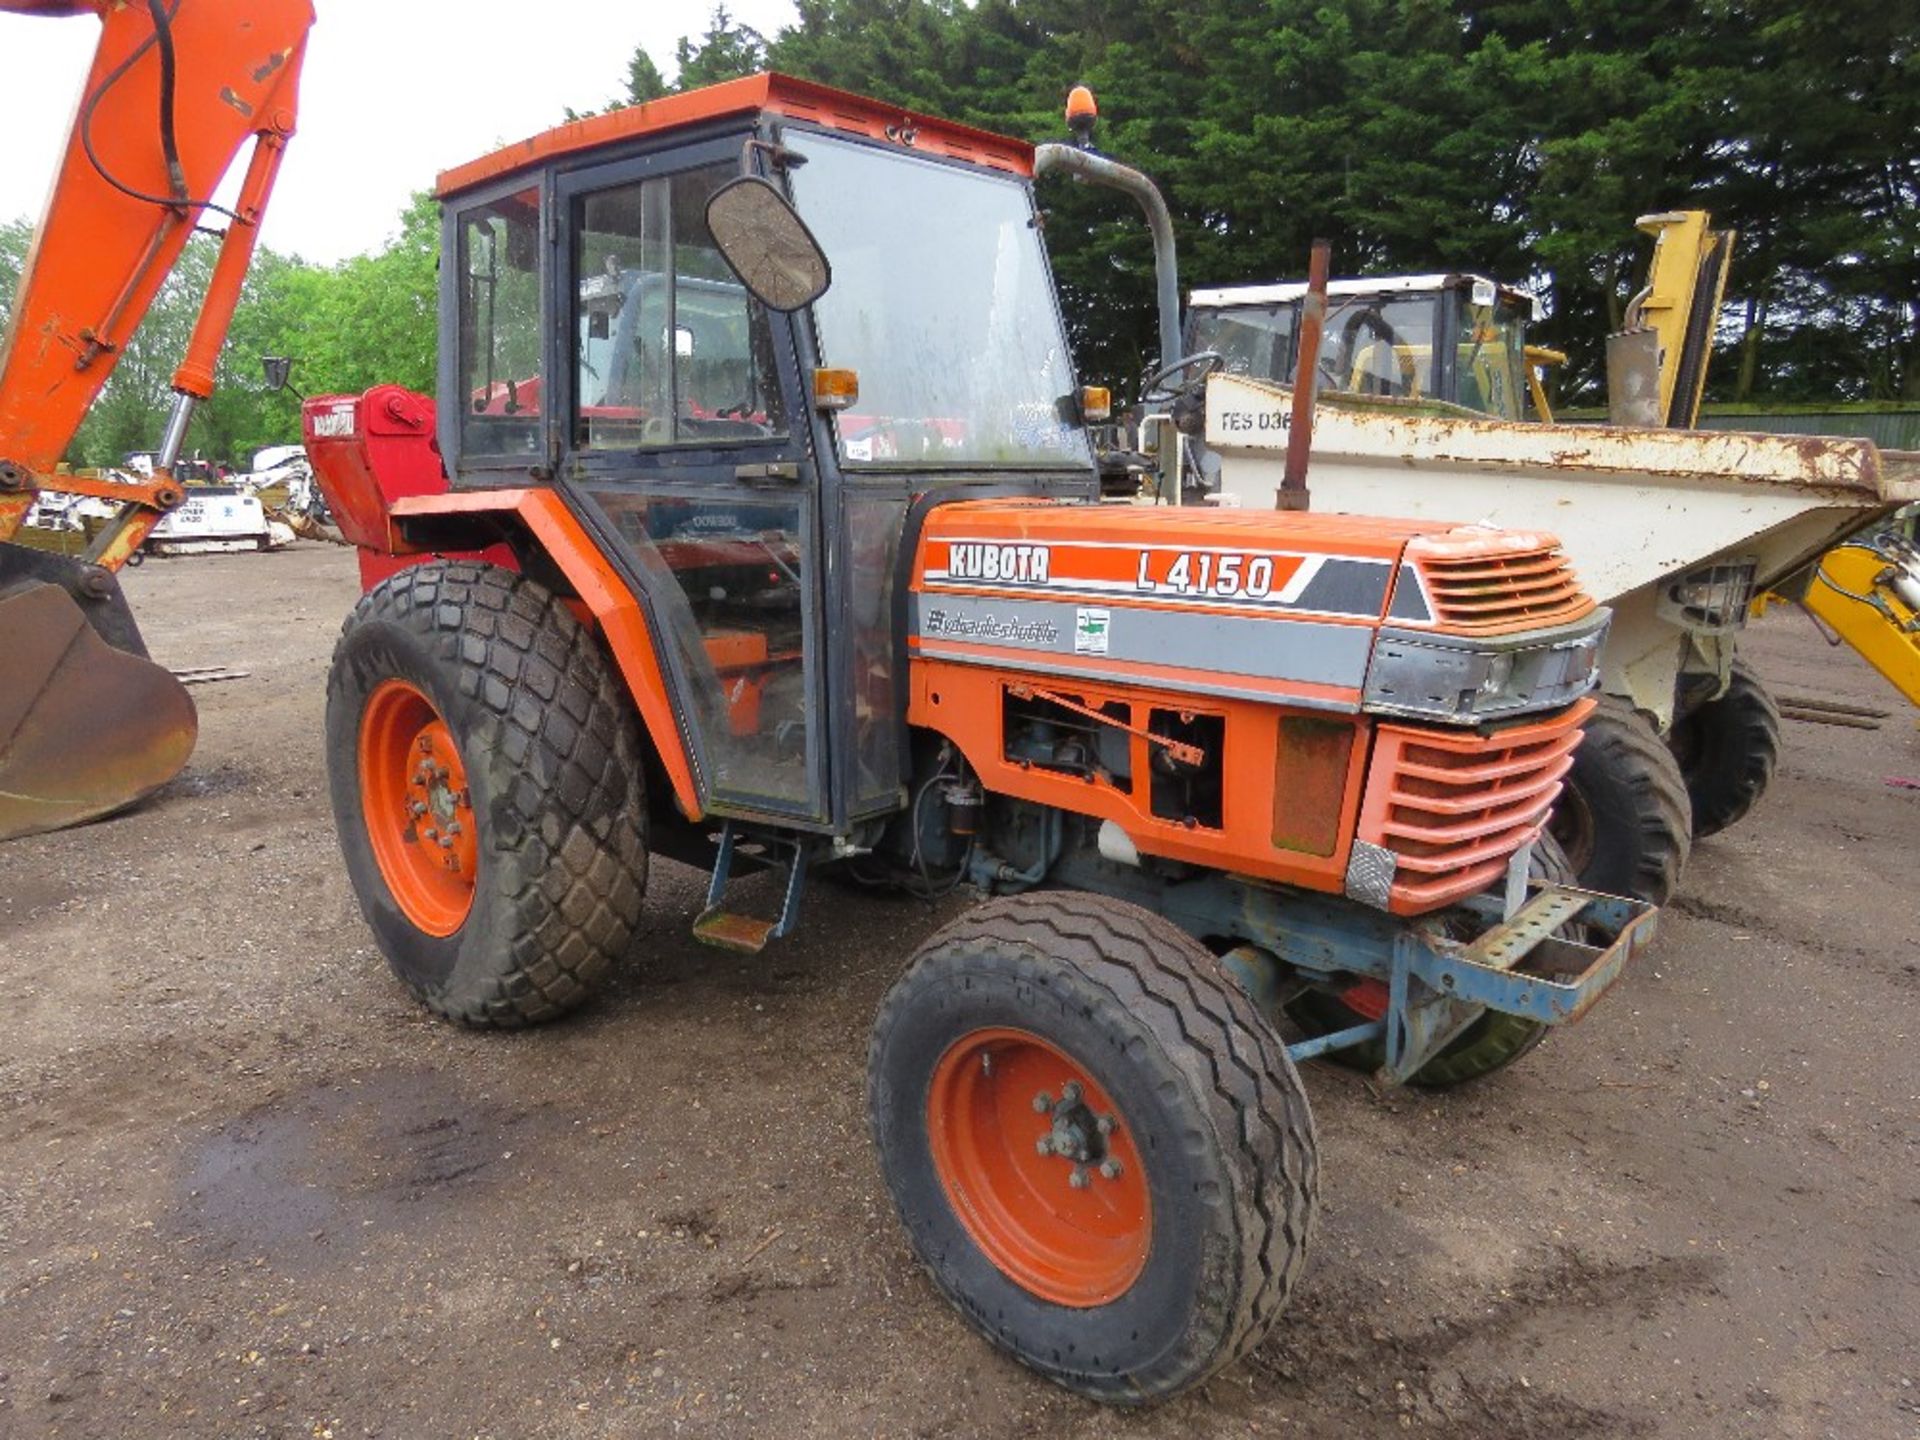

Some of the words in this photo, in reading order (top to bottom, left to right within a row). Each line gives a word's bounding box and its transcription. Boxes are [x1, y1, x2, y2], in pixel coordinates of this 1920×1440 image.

[949, 543, 1050, 584] KUBOTA
[1137, 551, 1156, 590] L
[1166, 552, 1274, 598] 4150
